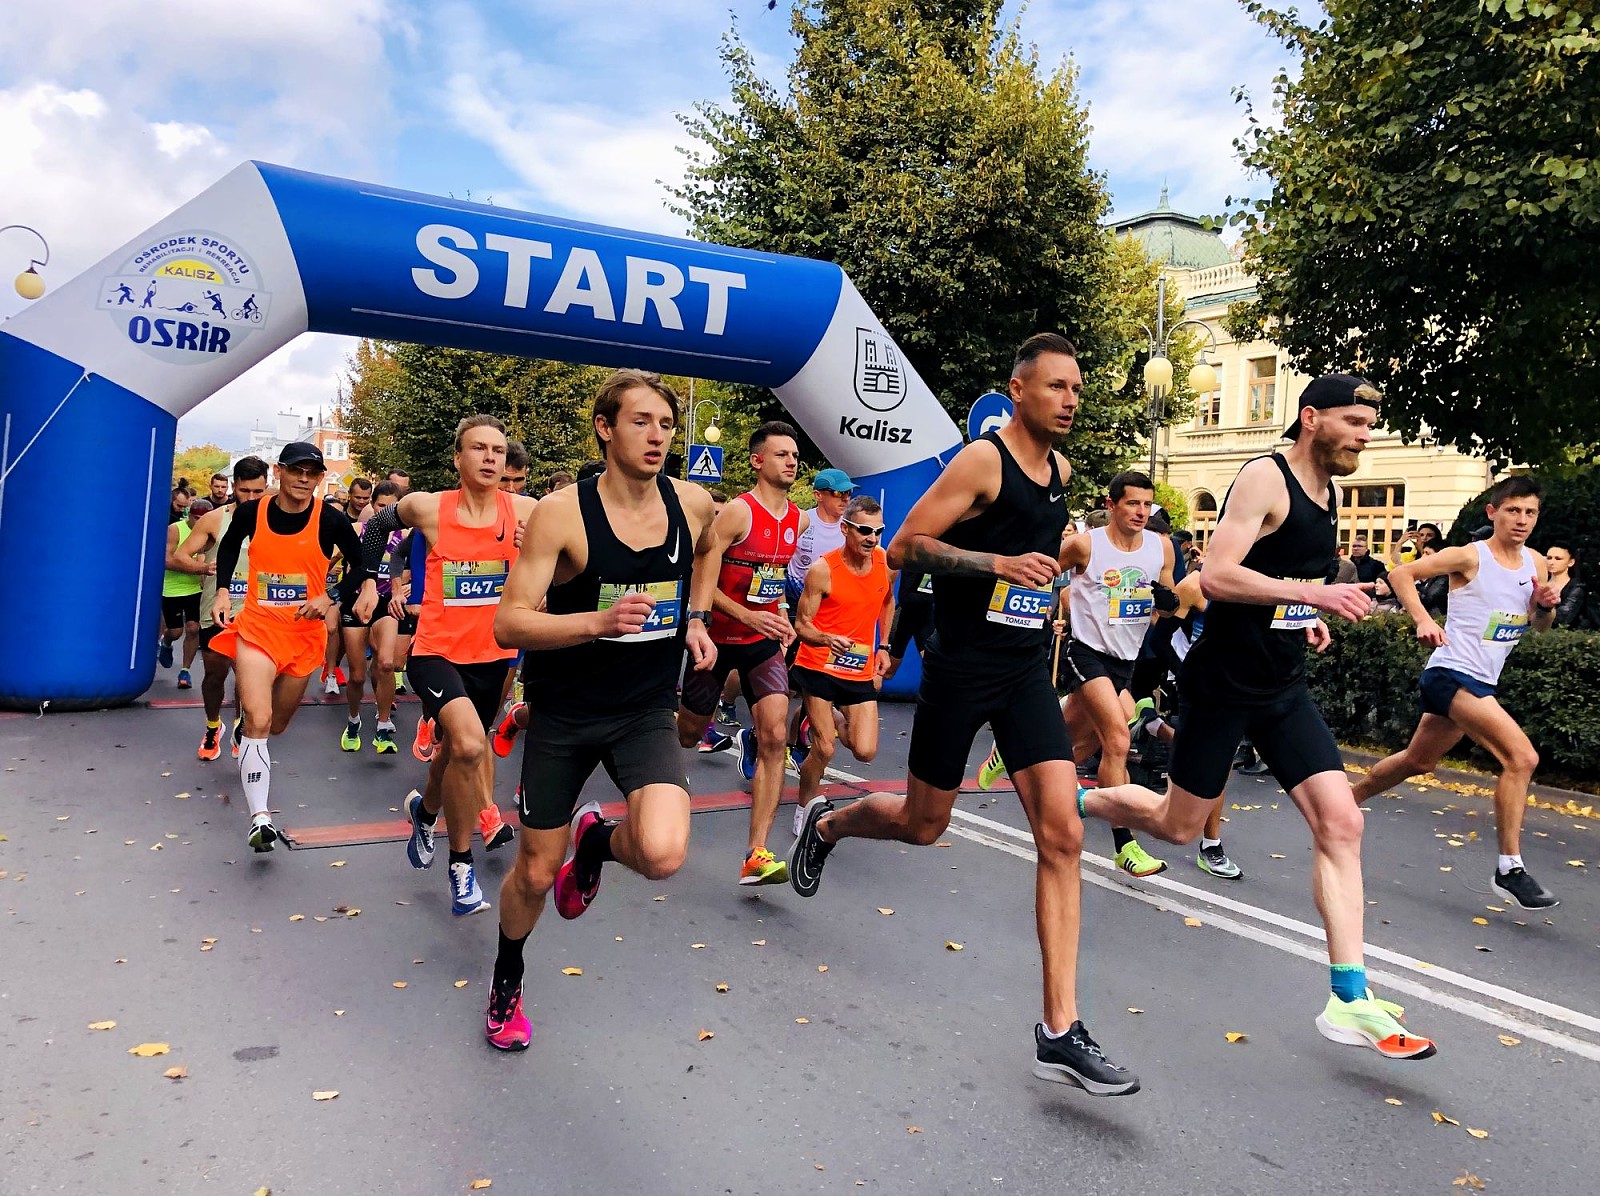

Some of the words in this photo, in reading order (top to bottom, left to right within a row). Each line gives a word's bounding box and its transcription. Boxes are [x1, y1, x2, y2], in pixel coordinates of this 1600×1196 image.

[134, 236, 197, 264] OŚRODEK
[201, 237, 250, 275] SPORTU
[139, 246, 194, 273] REHABILITACJI
[205, 250, 241, 284] REKREACJI
[411, 224, 747, 336] START
[839, 415, 913, 444] Kalisz
[271, 588, 296, 599] 169
[459, 580, 494, 596] 847
[761, 584, 780, 595] 555
[1008, 594, 1041, 614] 653
[1125, 603, 1142, 615] 93
[1005, 616, 1031, 627] TOMASZ
[1496, 628, 1519, 640] 846
[837, 656, 860, 667] 522
